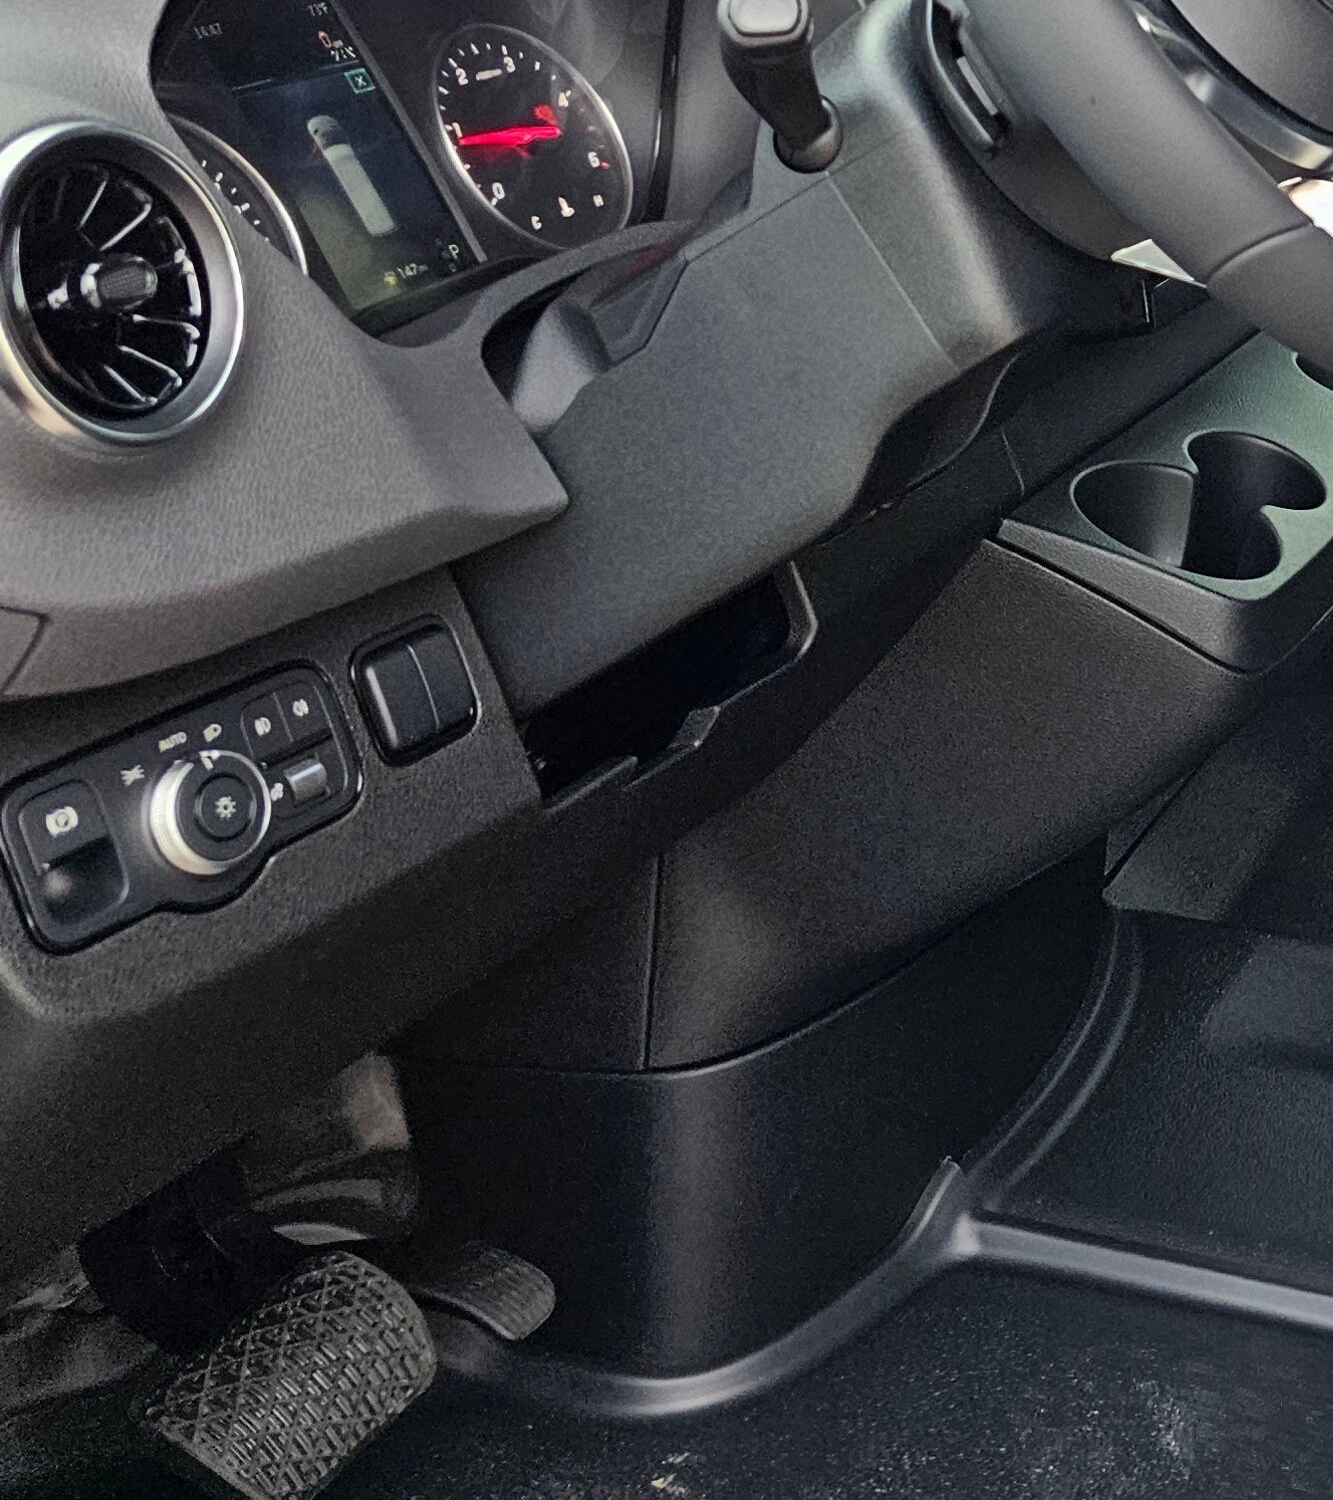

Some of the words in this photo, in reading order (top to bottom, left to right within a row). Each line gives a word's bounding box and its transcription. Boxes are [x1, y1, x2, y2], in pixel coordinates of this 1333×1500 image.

[503, 56, 516, 73] 3
[455, 67, 469, 85] 2
[491, 181, 505, 199] 0
[448, 244, 460, 260] P
[158, 731, 188, 752] AUTO
